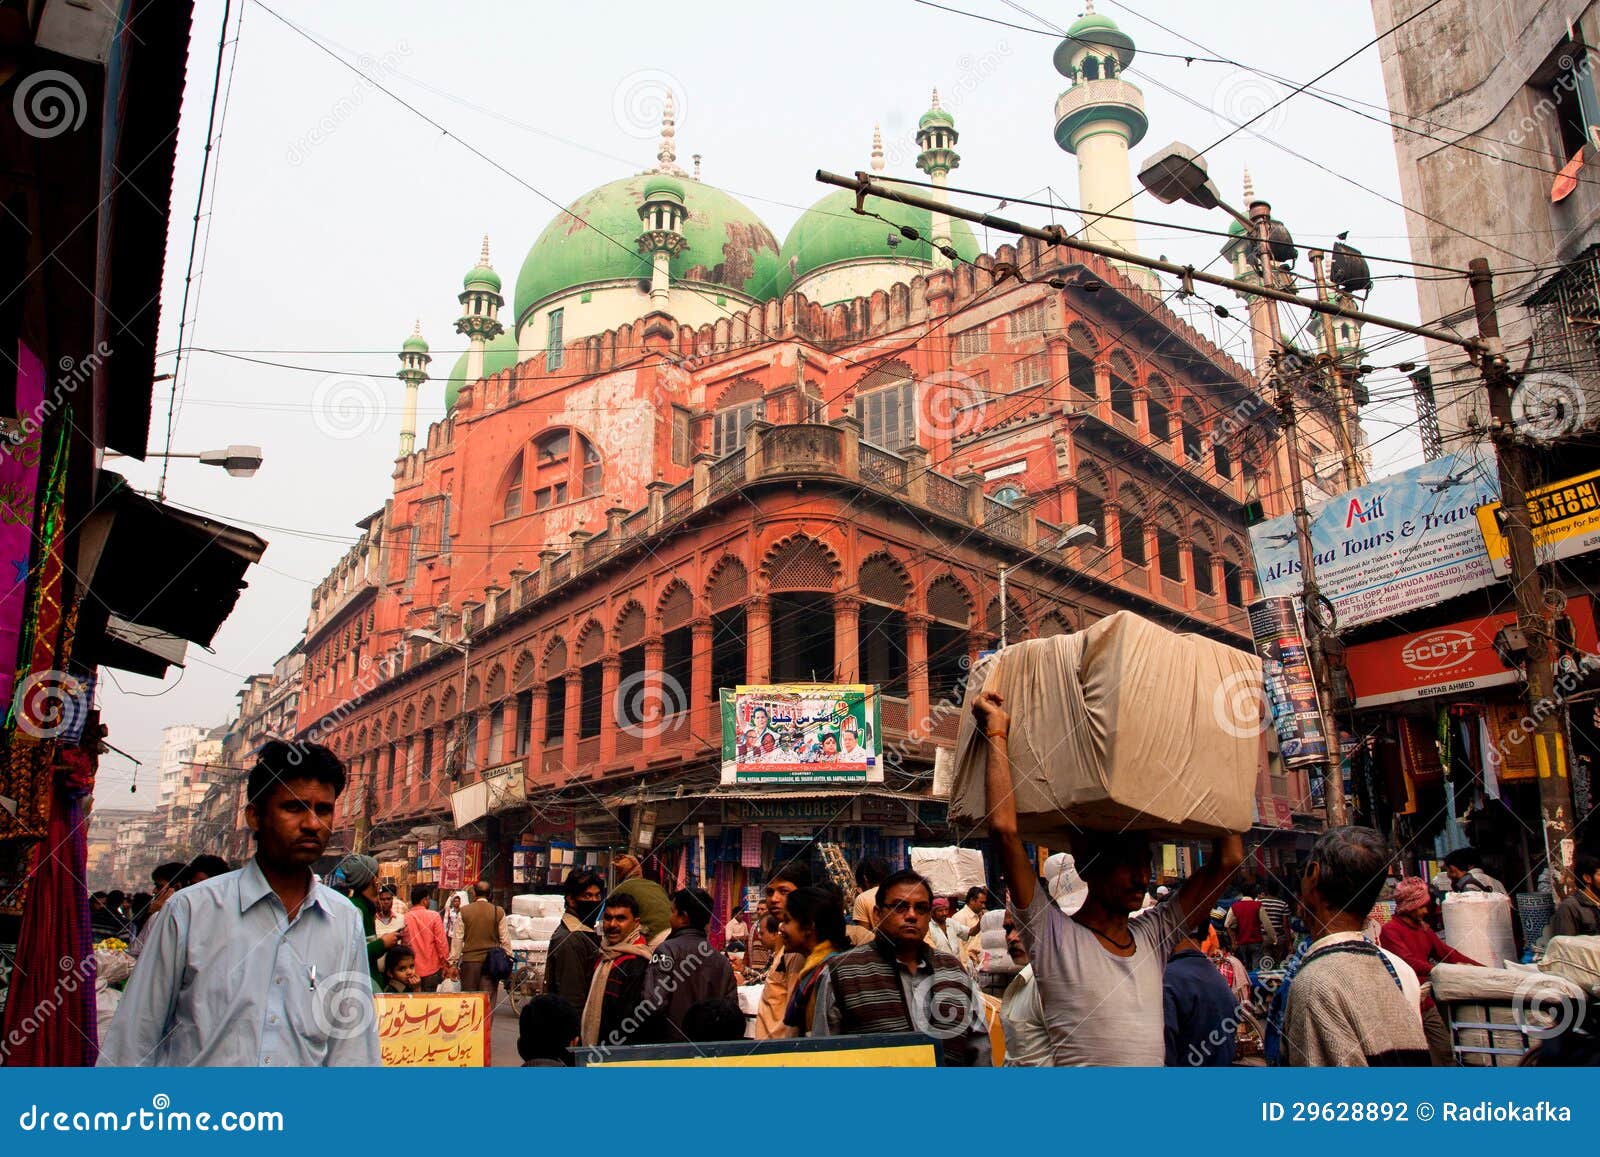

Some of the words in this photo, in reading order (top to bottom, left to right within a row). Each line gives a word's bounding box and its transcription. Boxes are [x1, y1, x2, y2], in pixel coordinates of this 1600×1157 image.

[1529, 495, 1597, 525] UNION
[1573, 517, 1586, 528] for
[1265, 548, 1336, 582] Al-Isaa
[1342, 530, 1394, 557] Tours
[1401, 520, 1416, 538] &
[1361, 559, 1371, 568] Air
[1372, 552, 1393, 564] Tickets
[1398, 543, 1422, 556] Foreign
[1423, 537, 1445, 549] Money
[1446, 528, 1474, 542] Changer
[1399, 563, 1417, 574] Work
[1418, 559, 1432, 569] Visa
[1433, 553, 1455, 564] Permit
[1461, 547, 1472, 557] Job
[1363, 563, 1389, 576] Passport
[1404, 549, 1437, 562] Assistance
[1383, 576, 1424, 595] NAKHUDA
[1401, 636, 1476, 664] SCOTT
[1417, 685, 1447, 697] MEHTAB
[1448, 680, 1475, 692] AHMED
[788, 801, 838, 817] STORES
